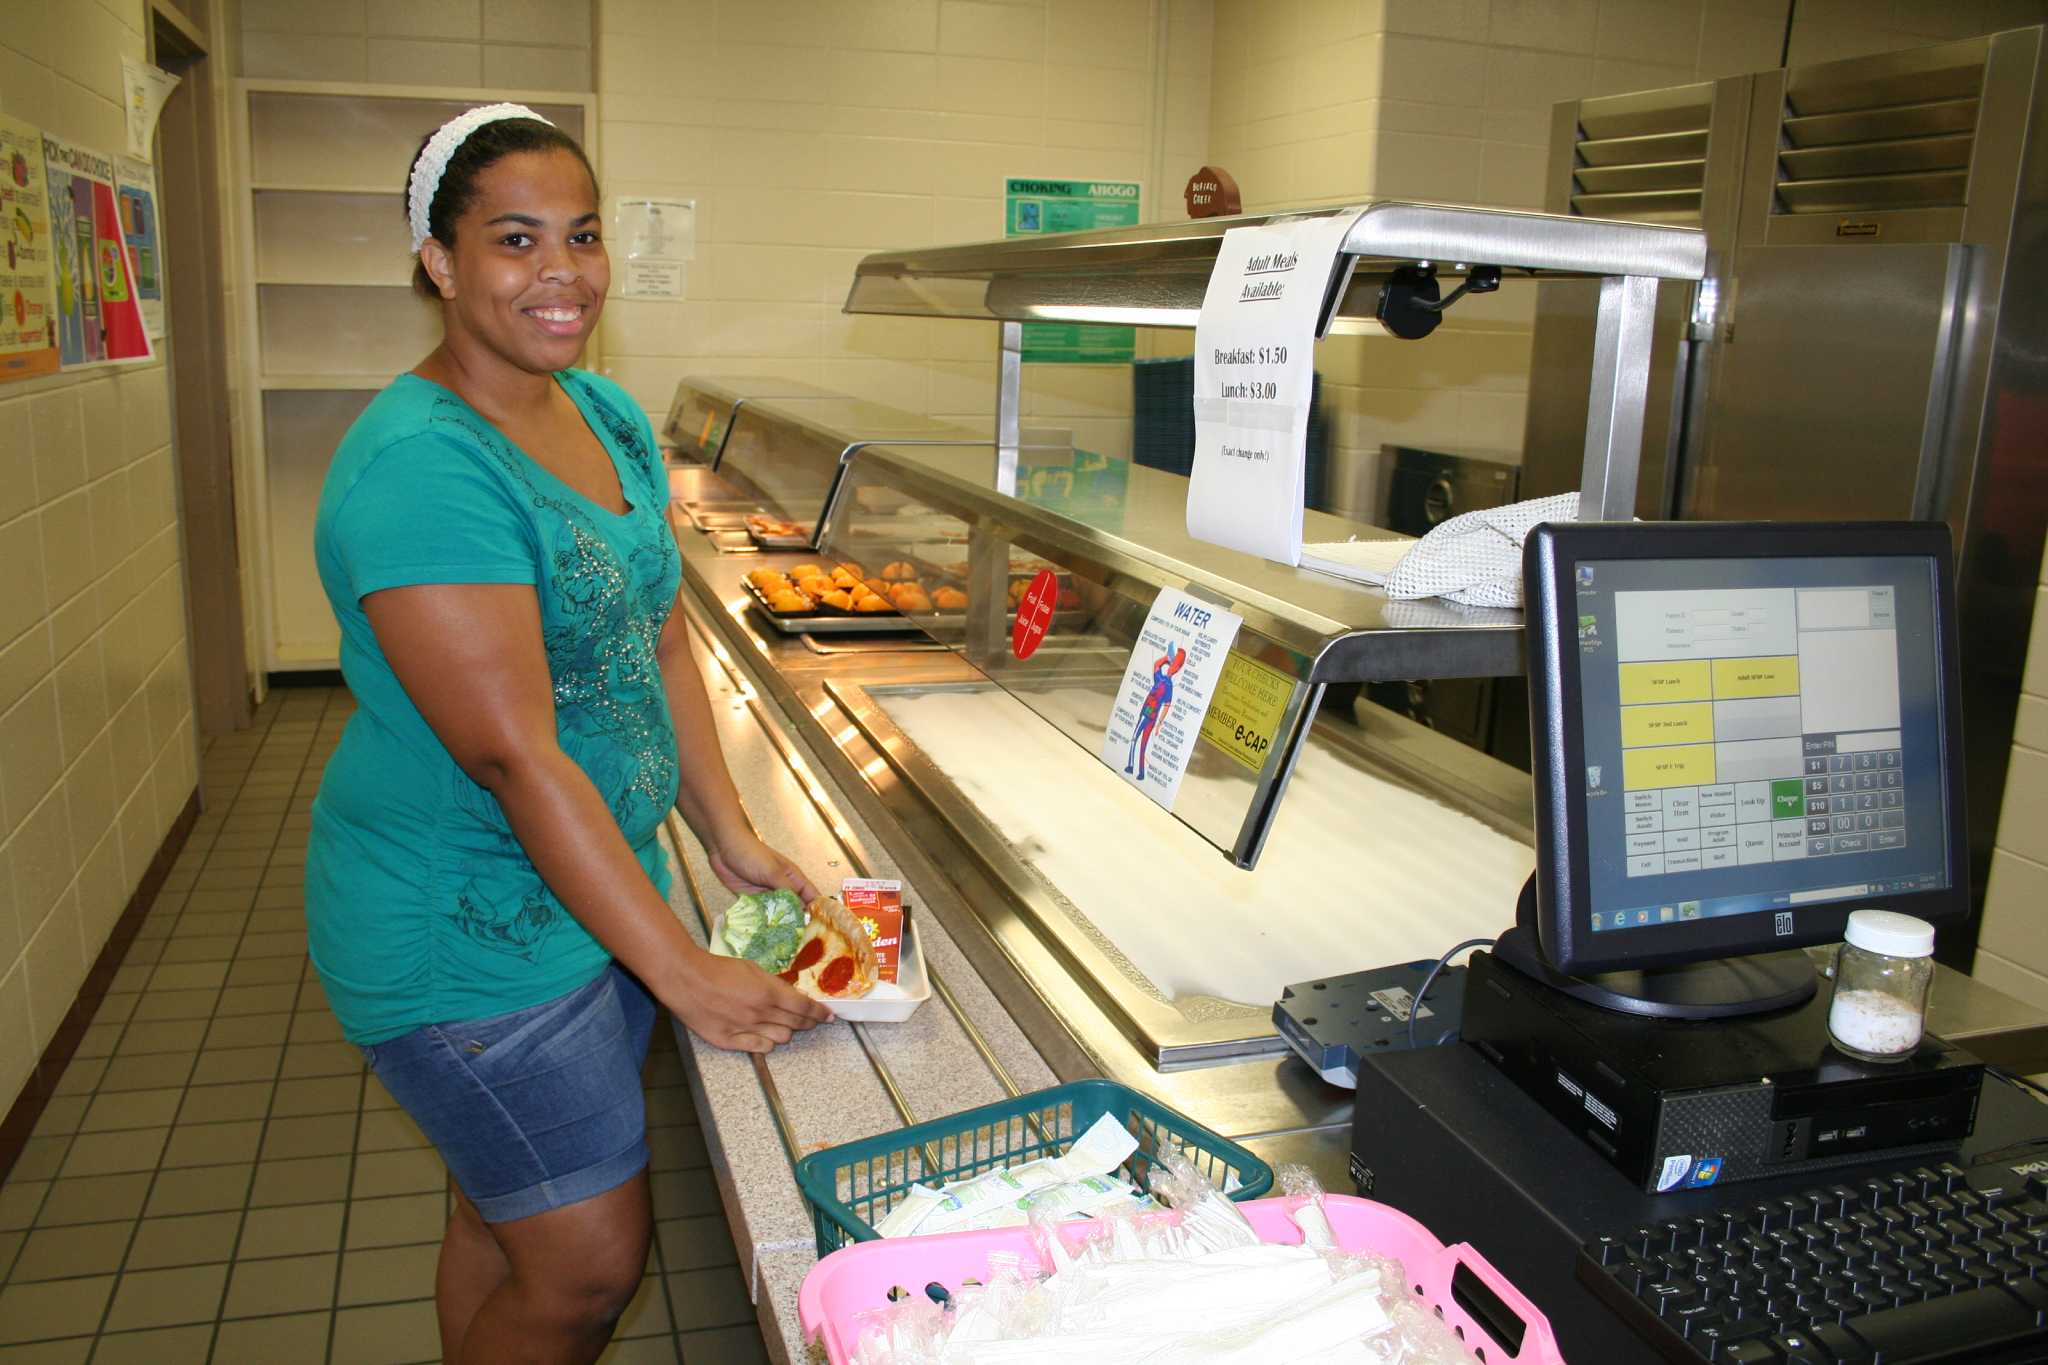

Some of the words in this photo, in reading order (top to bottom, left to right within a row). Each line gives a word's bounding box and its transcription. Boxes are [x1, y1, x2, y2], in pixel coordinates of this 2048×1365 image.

[1010, 182, 1071, 195] CHOKING
[1246, 255, 1271, 272] Adult
[1272, 251, 1299, 270] Meals
[1241, 280, 1285, 299] Available:
[1214, 349, 1255, 365] Breakfast:
[1258, 346, 1288, 365] $1.50
[1221, 381, 1248, 399] Lunch:
[1250, 381, 1277, 400] $3.00
[1173, 601, 1212, 630] WATER
[1234, 724, 1268, 754] e-CAP
[1805, 742, 1822, 750] Enter
[1823, 740, 1835, 748] PIN
[1810, 760, 1821, 771] $1
[1838, 756, 1844, 769] 7
[1862, 755, 1870, 768] 8
[1886, 753, 1894, 766] 9
[1838, 777, 1846, 789] 4
[1863, 775, 1871, 787] 5
[1887, 773, 1895, 785] 6
[1811, 781, 1823, 791] $5
[1672, 800, 1689, 808] Clear
[1840, 797, 1846, 809] 1
[1864, 795, 1872, 808] 2
[1888, 792, 1896, 805] 3
[1810, 801, 1825, 812] $10
[1811, 821, 1826, 831] $20
[1837, 817, 1851, 831] 00
[1865, 815, 1873, 827] 0
[1839, 839, 1863, 849] Check
[1879, 834, 1898, 845] Enter
